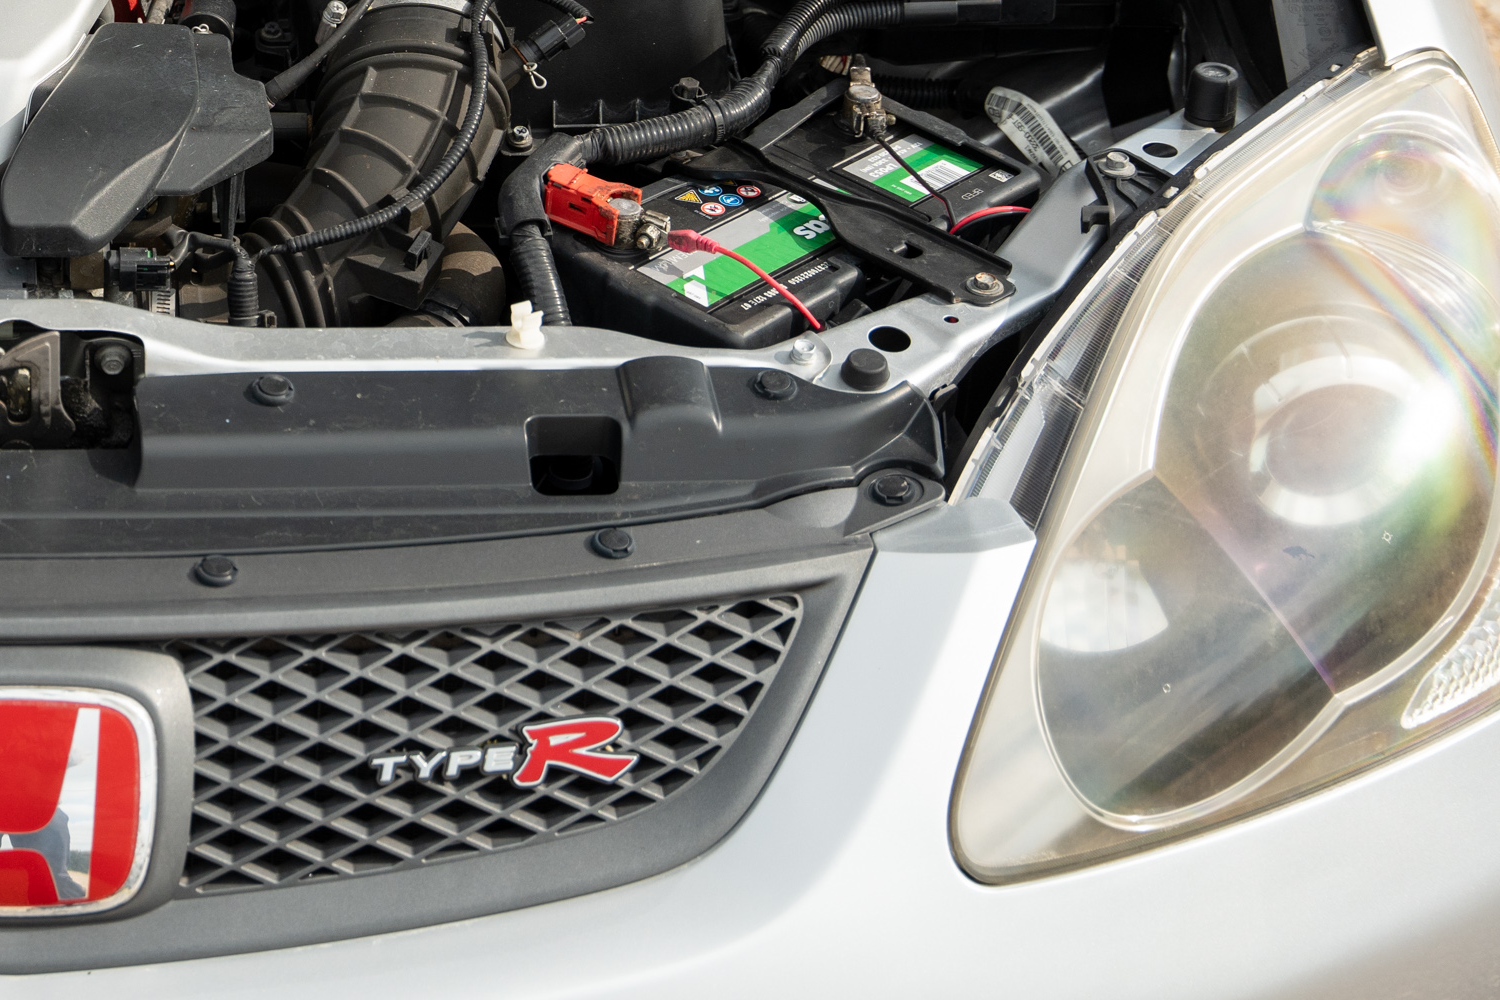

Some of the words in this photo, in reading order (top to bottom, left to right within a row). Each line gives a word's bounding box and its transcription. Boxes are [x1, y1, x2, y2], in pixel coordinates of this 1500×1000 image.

[793, 214, 831, 240] as
[370, 742, 518, 784] TYPE
[511, 715, 640, 788] R
